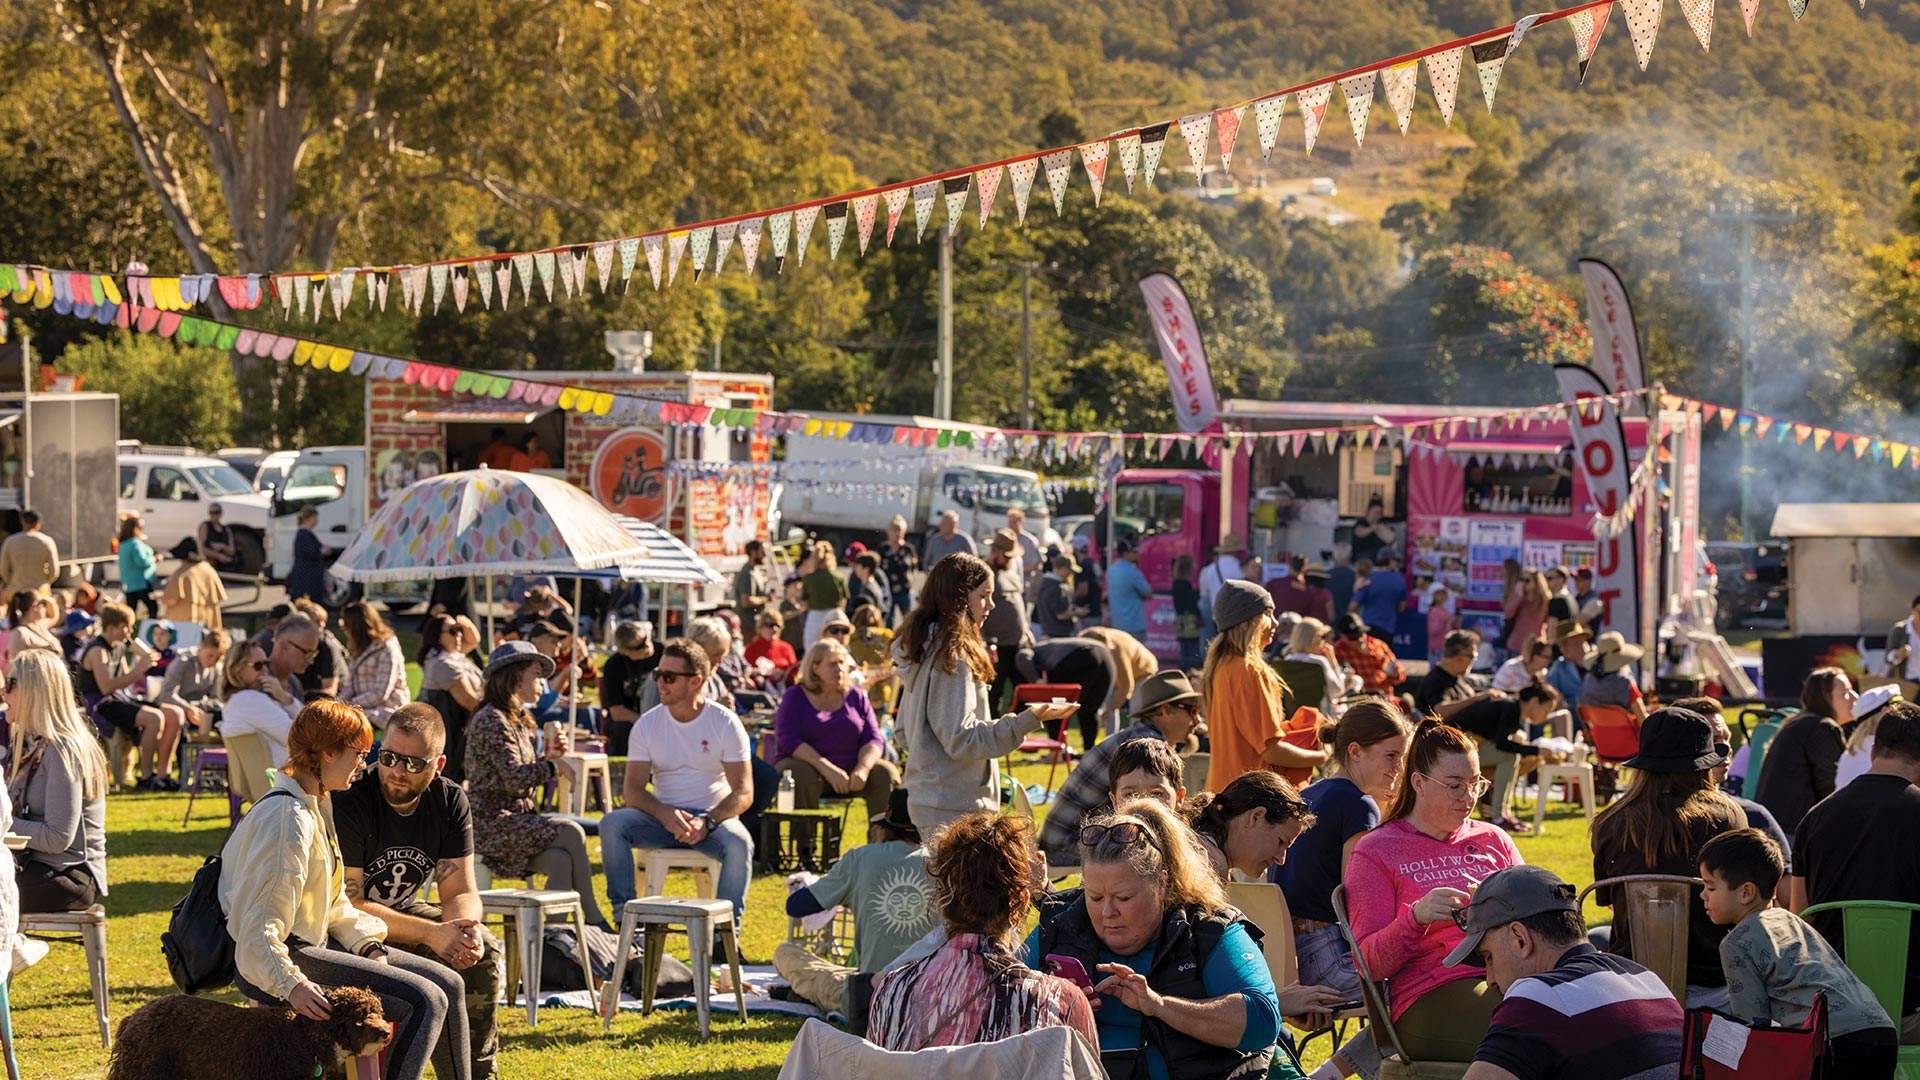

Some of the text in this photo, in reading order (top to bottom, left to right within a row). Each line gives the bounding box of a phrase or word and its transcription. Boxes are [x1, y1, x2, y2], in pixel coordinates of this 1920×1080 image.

[1161, 296, 1202, 417] SHAKES
[386, 849, 428, 866] PICKLES
[1399, 854, 1478, 875] HOLLYWO
